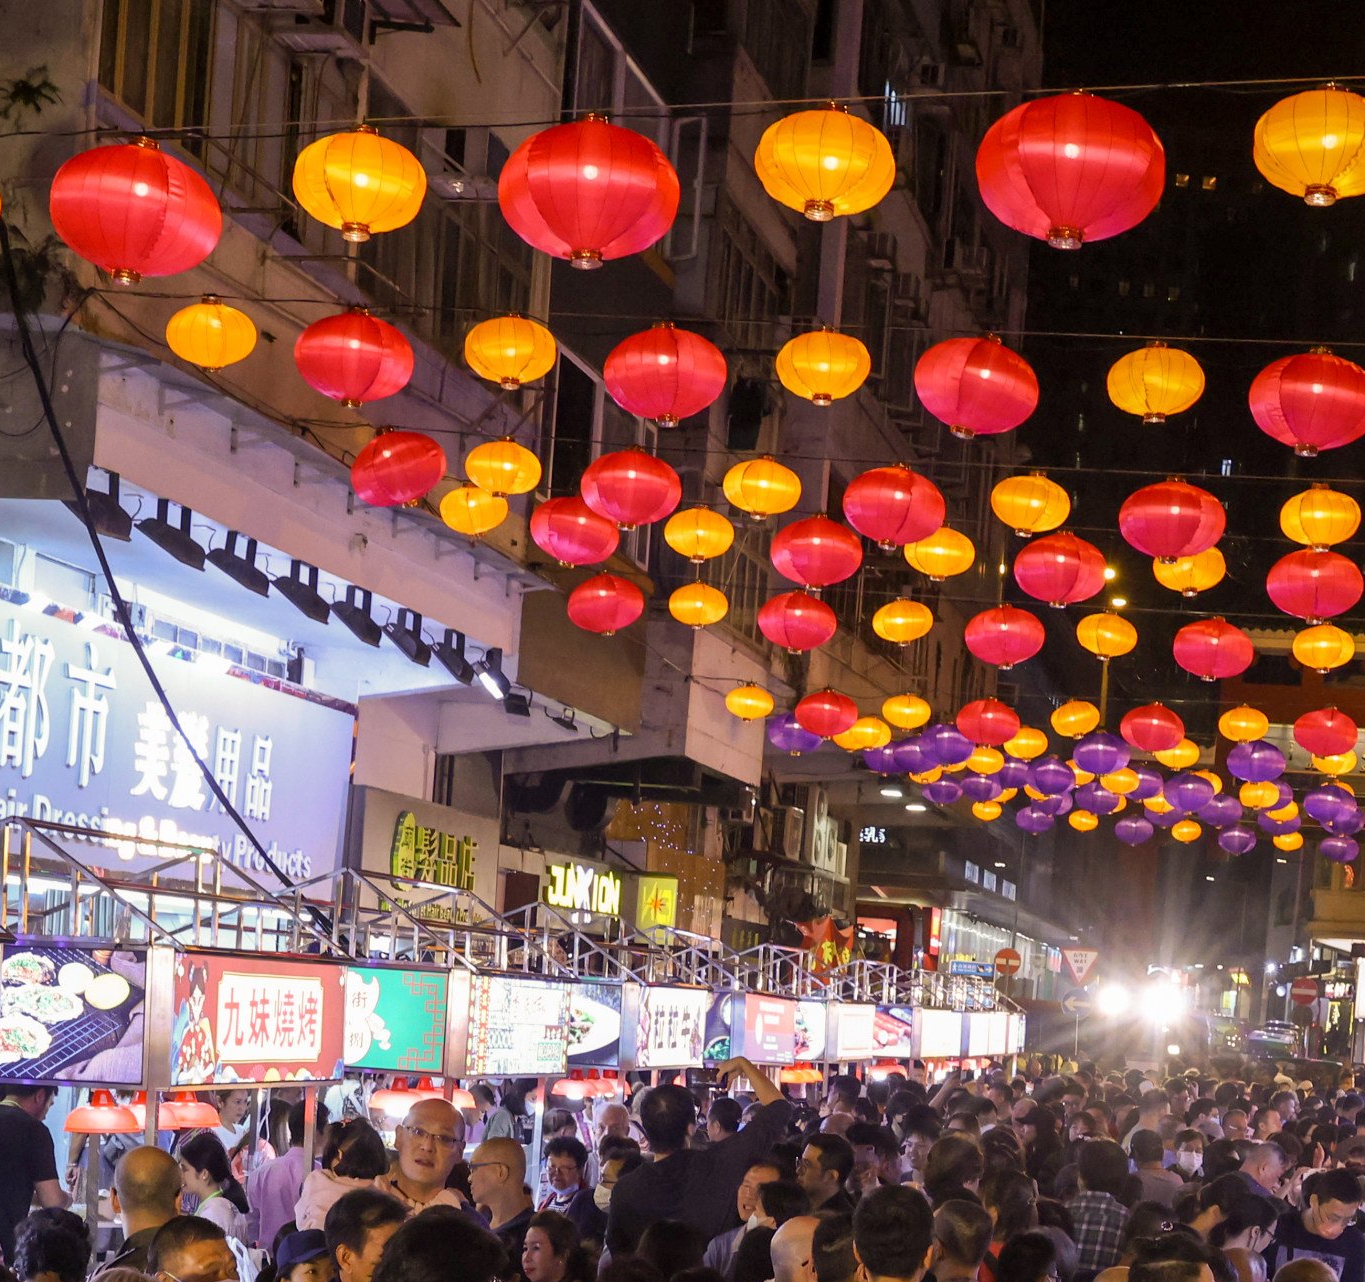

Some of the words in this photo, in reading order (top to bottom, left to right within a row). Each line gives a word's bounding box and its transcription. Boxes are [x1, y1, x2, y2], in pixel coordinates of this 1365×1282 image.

[233, 834, 312, 880] Products
[221, 986, 319, 1050] 九妹燒烤
